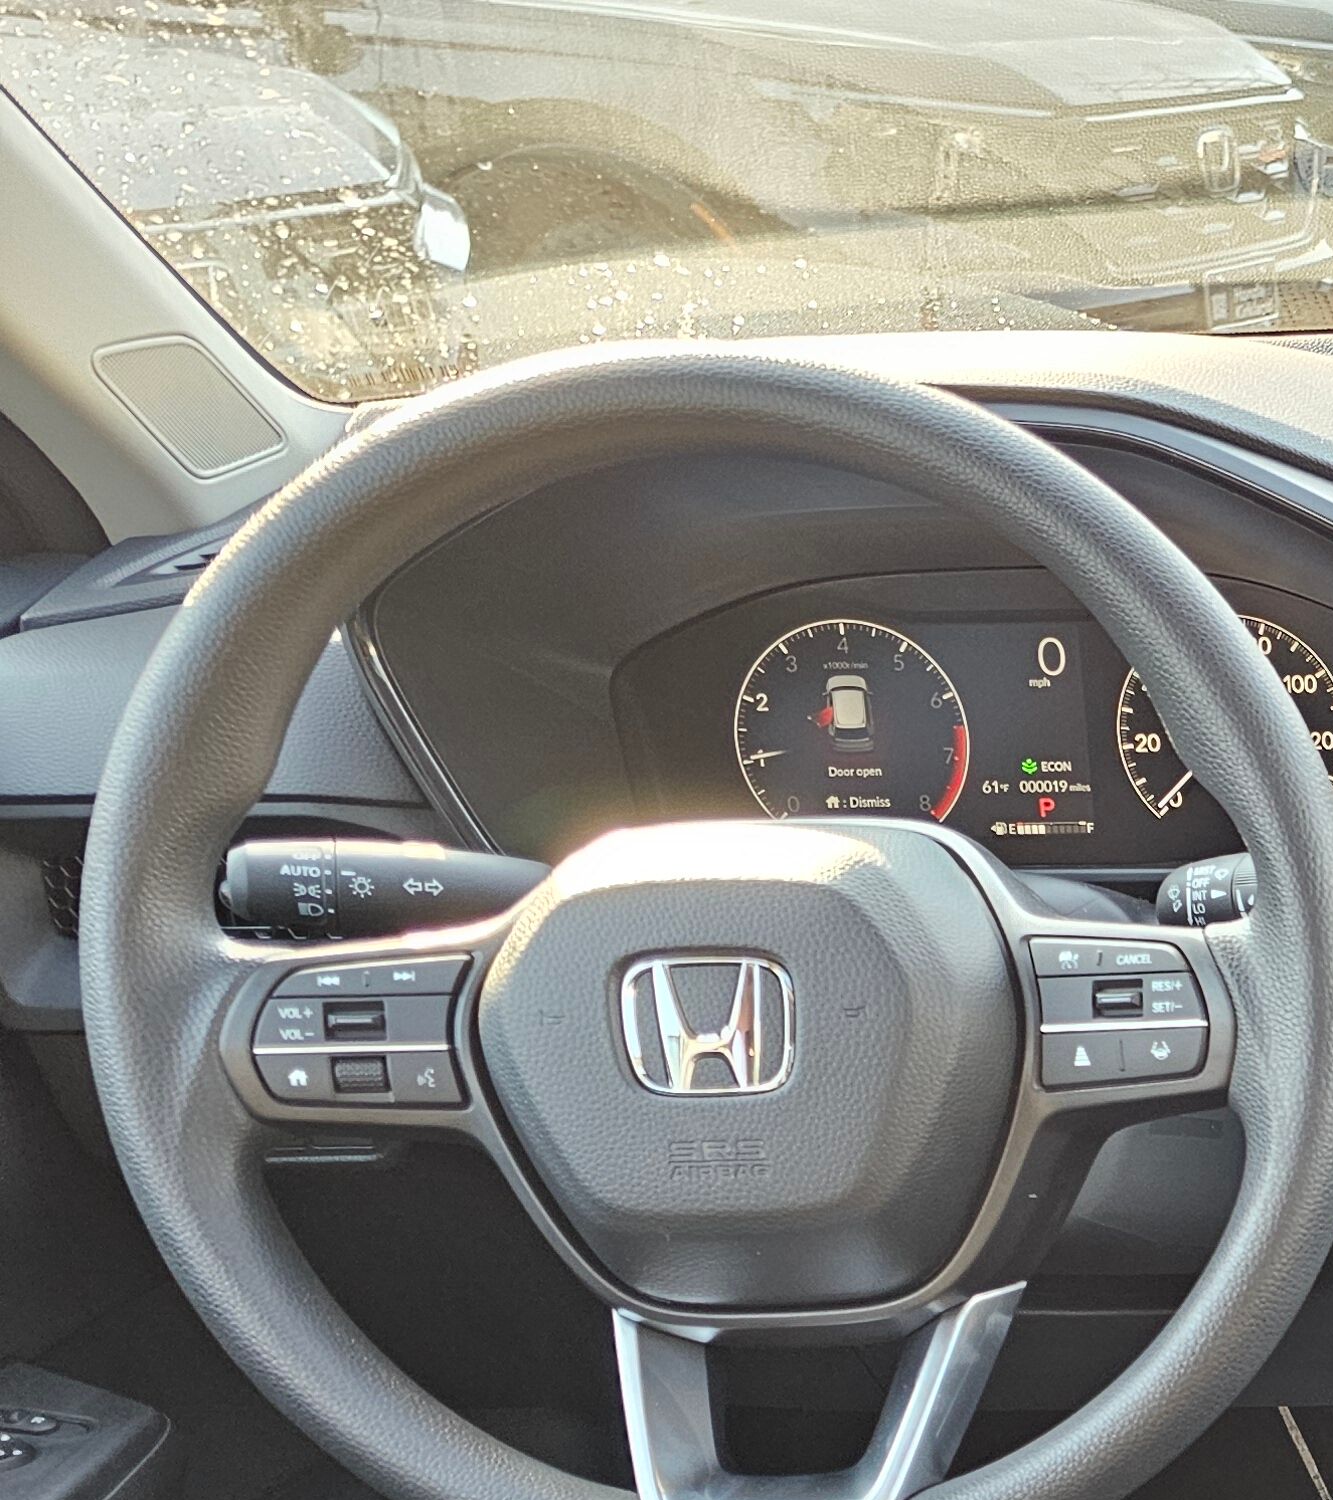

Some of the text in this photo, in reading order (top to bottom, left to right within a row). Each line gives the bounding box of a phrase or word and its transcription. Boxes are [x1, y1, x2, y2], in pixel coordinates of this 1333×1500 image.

[836, 637, 849, 654] 4
[785, 656, 798, 672] 3
[893, 654, 905, 672] 5
[1037, 636, 1067, 677] 0
[1029, 677, 1051, 688] mph
[1283, 674, 1318, 694] 100
[756, 693, 769, 711] 2
[930, 692, 943, 709] 6
[1134, 732, 1162, 753] 20
[943, 747, 955, 764] 7
[828, 767, 882, 778] Door open
[1041, 760, 1073, 772] ECON
[1019, 779, 1091, 794] 000019 miles
[787, 796, 800, 812] 0
[849, 796, 891, 809] Dismiss
[919, 795, 932, 811] 8
[1038, 797, 1056, 818] P
[1008, 823, 1017, 835] E
[1086, 822, 1095, 834] F
[280, 864, 321, 878] AUTO
[1191, 878, 1211, 889] OFF
[1192, 889, 1208, 902] INT
[1192, 903, 1206, 914] LO
[1116, 953, 1153, 966] CANCEL
